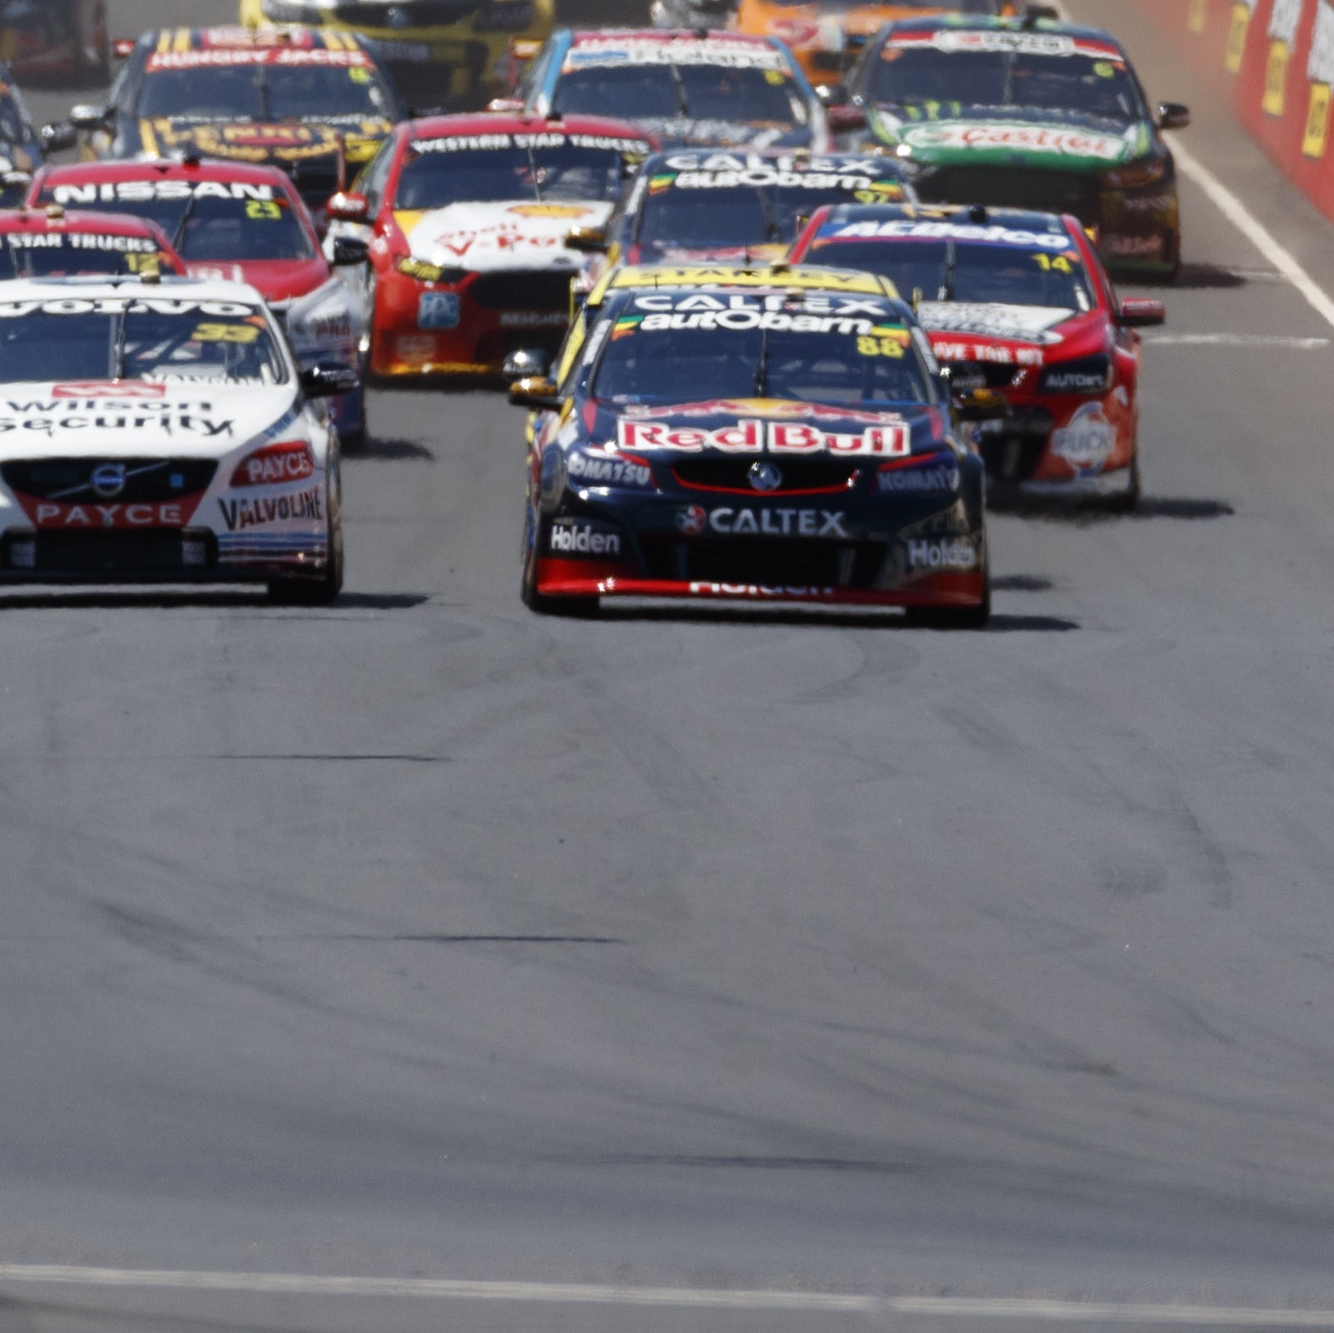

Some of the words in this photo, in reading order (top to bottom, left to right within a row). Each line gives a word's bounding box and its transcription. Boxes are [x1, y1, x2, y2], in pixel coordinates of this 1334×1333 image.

[412, 135, 509, 152] WESTERN
[514, 134, 564, 147] STAR
[569, 134, 652, 154] TRUCKS
[963, 127, 1107, 154] Castrol
[54, 181, 273, 203] NISSAN
[246, 200, 282, 219] 23
[7, 232, 62, 248] STAR
[68, 234, 157, 253] TRUCKS
[1031, 253, 1072, 274] 14
[639, 267, 854, 283] STANEY
[191, 323, 260, 343] 33
[856, 337, 905, 358] 88
[624, 421, 758, 451] Red
[774, 424, 904, 453] Bull
[247, 451, 310, 482] PAYCE
[36, 503, 182, 525] PAYCE
[218, 486, 324, 533] VALVOLINE
[709, 507, 848, 538] CALTEX
[551, 525, 621, 553] Holden
